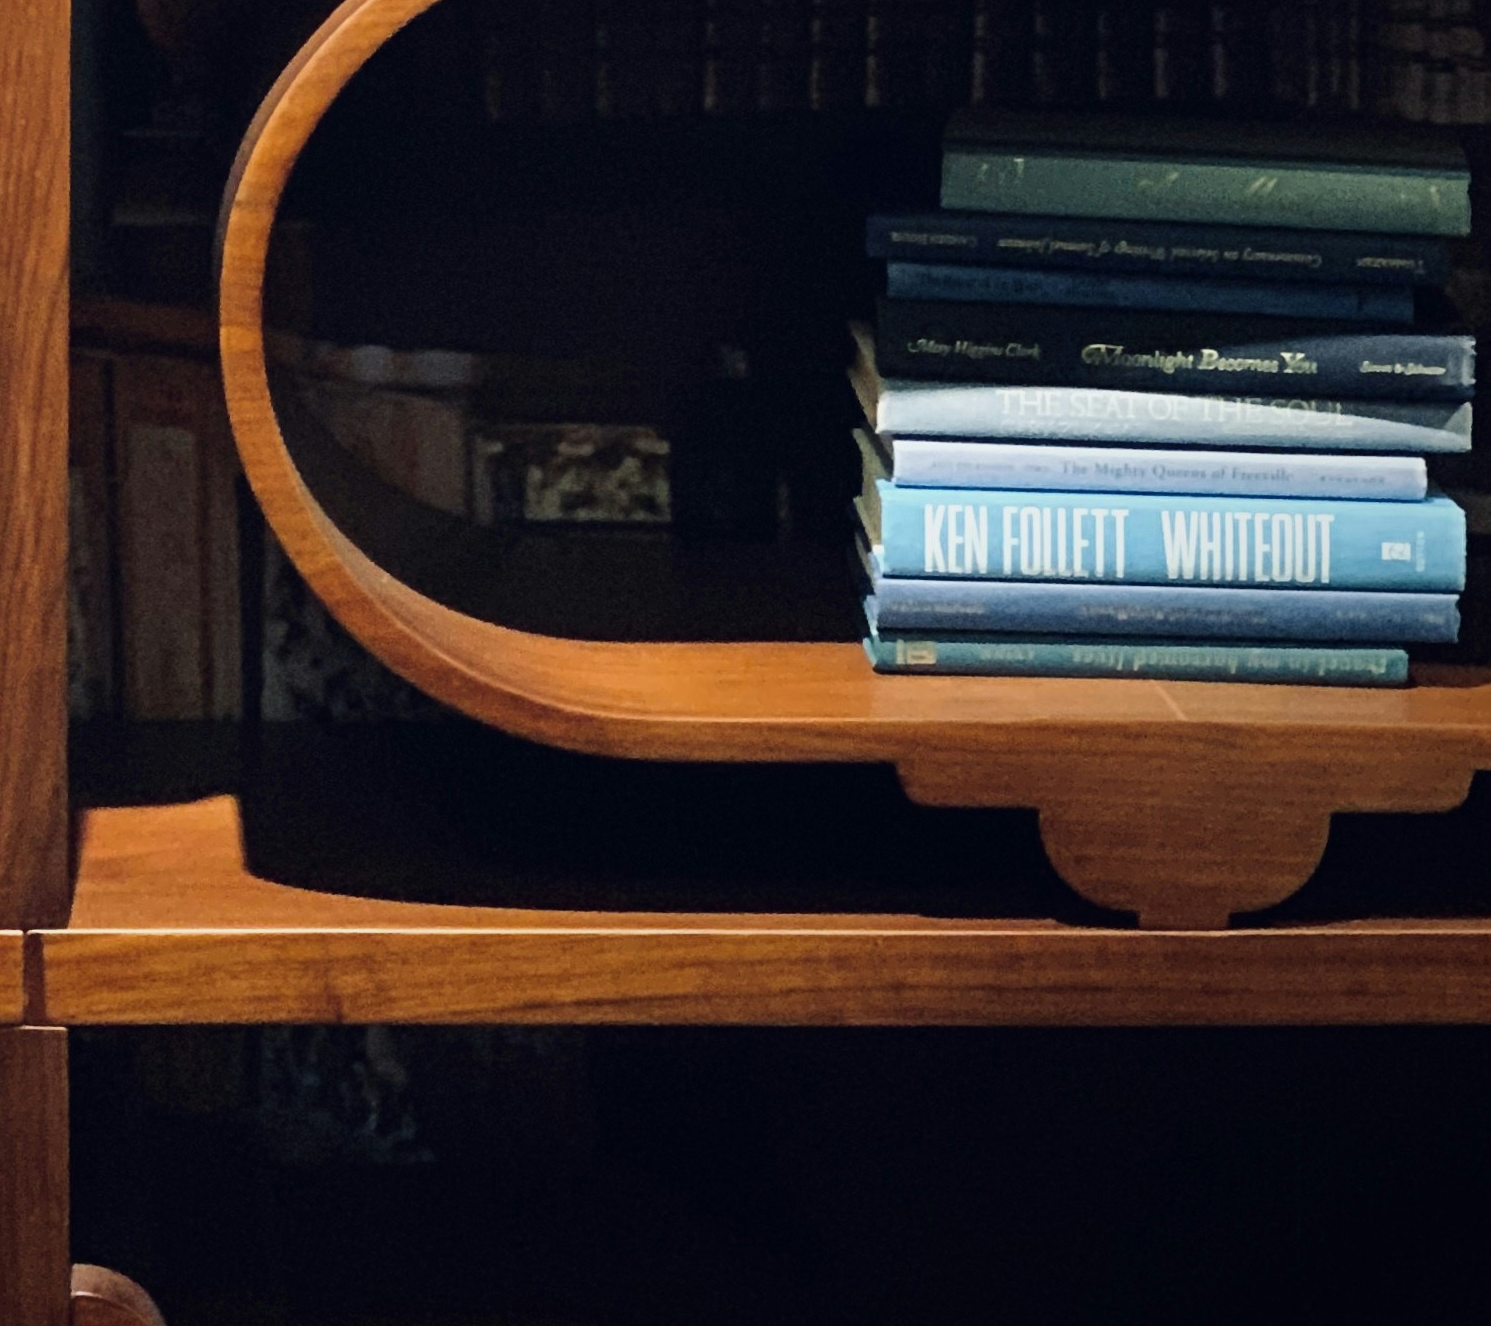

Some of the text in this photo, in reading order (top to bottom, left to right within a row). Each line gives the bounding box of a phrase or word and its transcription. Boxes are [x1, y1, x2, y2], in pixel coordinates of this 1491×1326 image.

[1081, 344, 1194, 374] Moonlight
[1198, 349, 1279, 374] Becomes
[995, 389, 1354, 427] THE SEAT OF THE SOUL
[924, 504, 988, 574] KEN
[1003, 505, 1129, 578] FOLLETT
[1161, 509, 1335, 584] WHITEOUT
